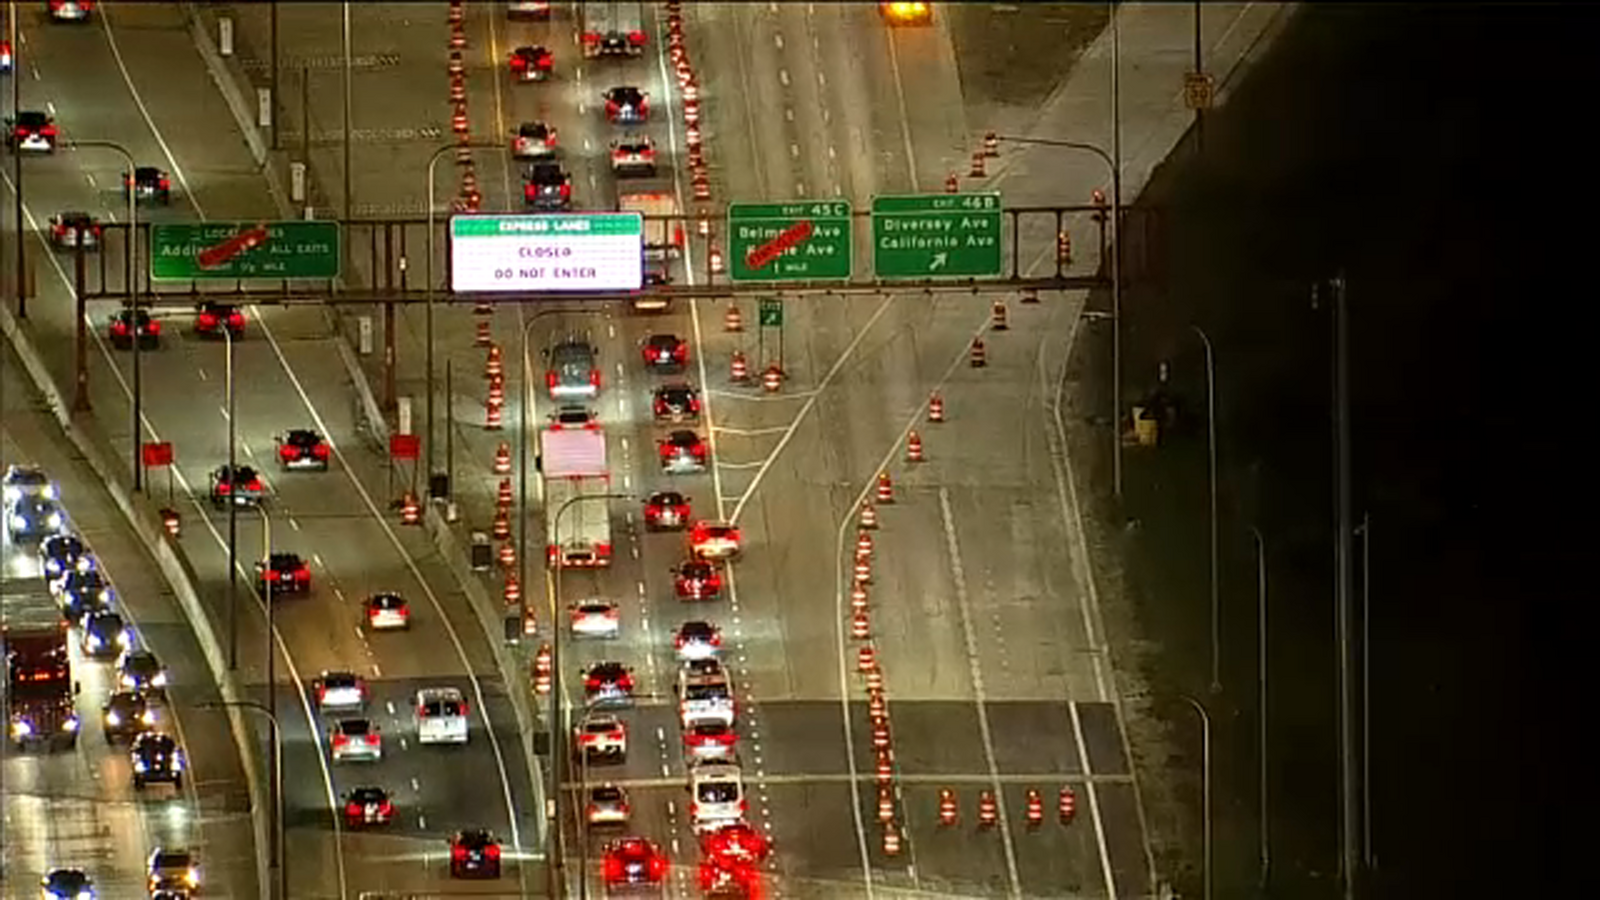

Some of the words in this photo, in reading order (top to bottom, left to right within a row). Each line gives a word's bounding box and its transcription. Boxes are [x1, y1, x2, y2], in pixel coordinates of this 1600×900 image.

[884, 218, 953, 231] Diversey
[961, 217, 988, 229] Ave
[812, 226, 840, 237] Ave
[881, 235, 959, 248] California
[967, 235, 994, 247] Ave
[519, 247, 572, 258] CLOSED
[806, 243, 834, 255] Ave
[494, 268, 513, 279] DO
[519, 267, 545, 278] NOT
[554, 267, 596, 278] ENTER
